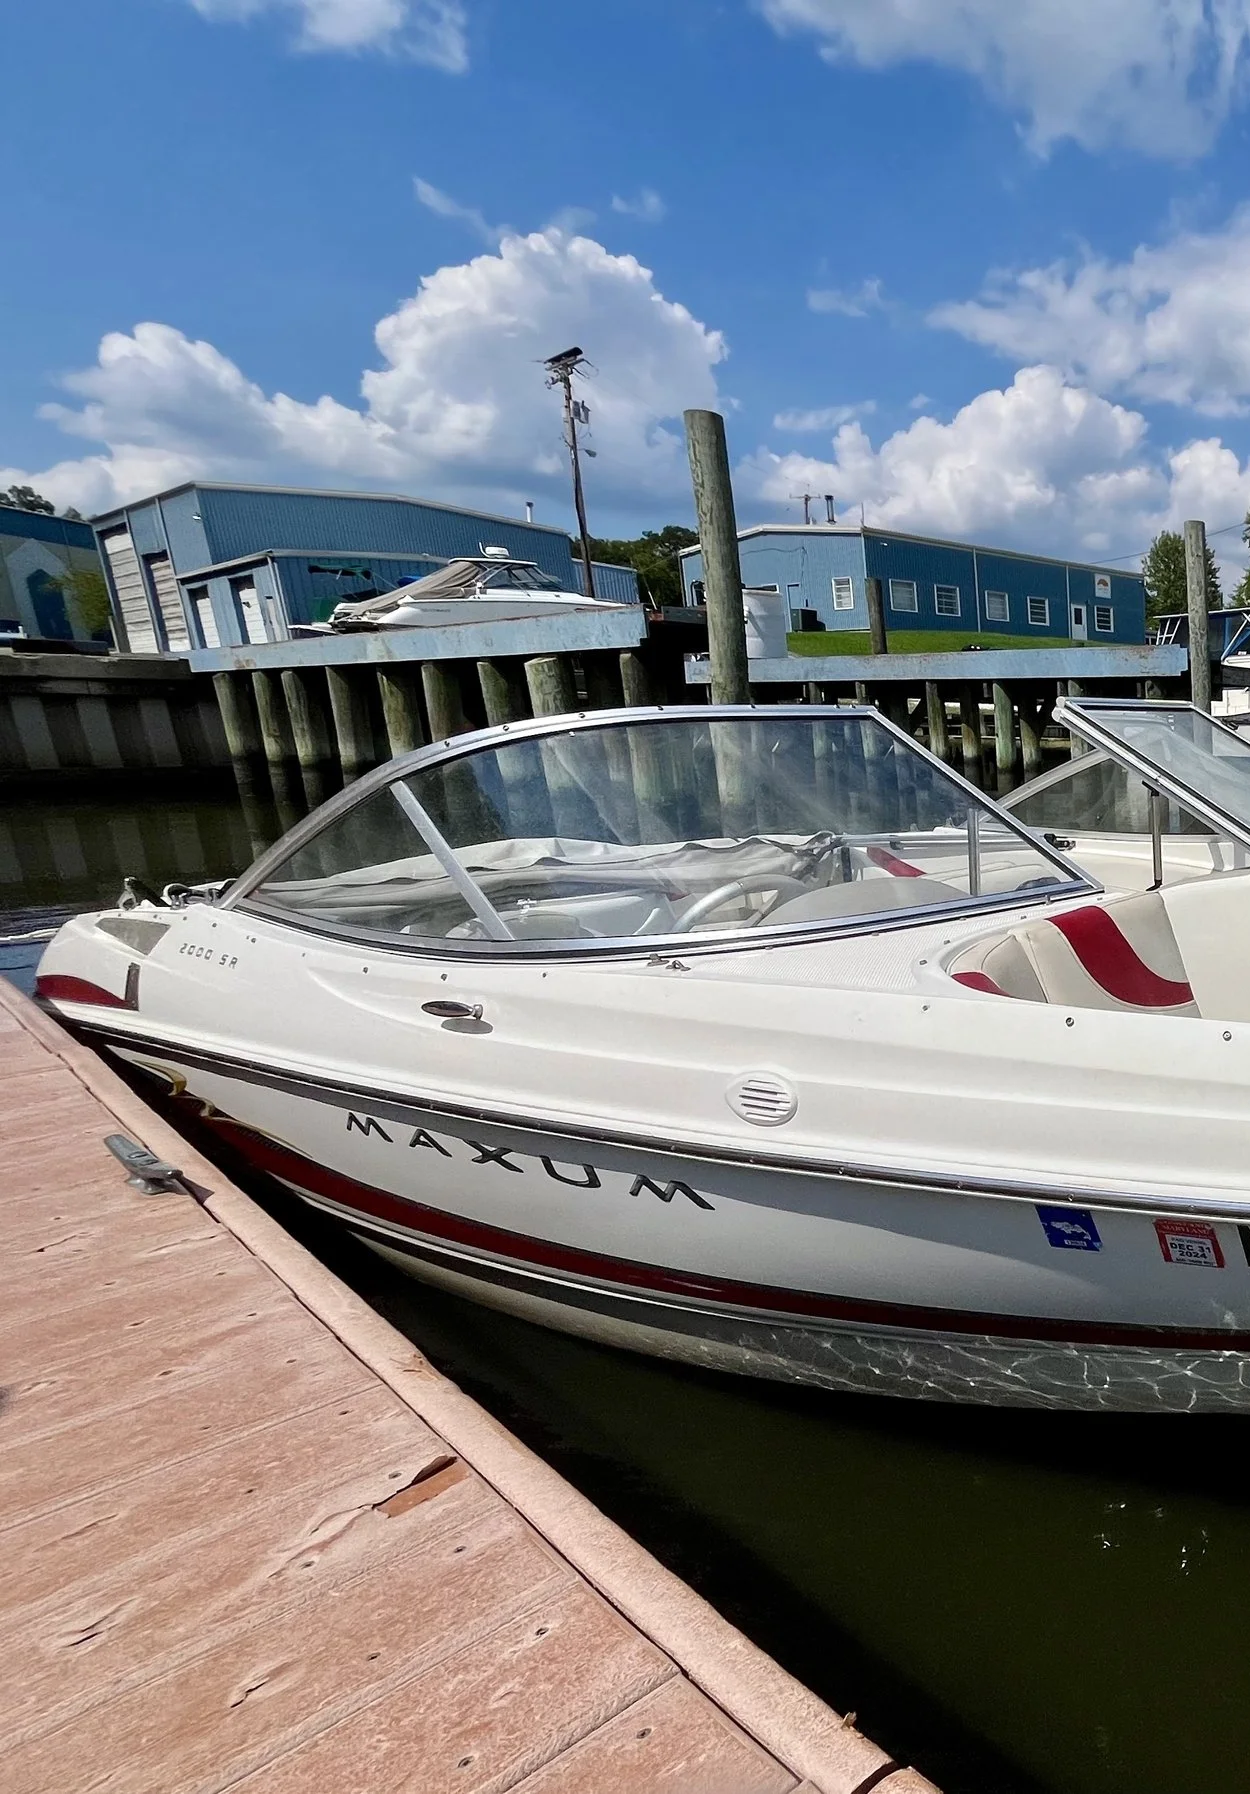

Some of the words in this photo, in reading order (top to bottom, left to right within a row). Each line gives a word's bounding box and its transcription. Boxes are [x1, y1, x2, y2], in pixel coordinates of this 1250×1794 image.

[180, 943, 213, 960] 2000
[346, 1111, 715, 1211] MAXUM
[1169, 1242, 1194, 1251] DEC
[1198, 1246, 1212, 1254] 31
[1178, 1250, 1208, 1259] 2024
